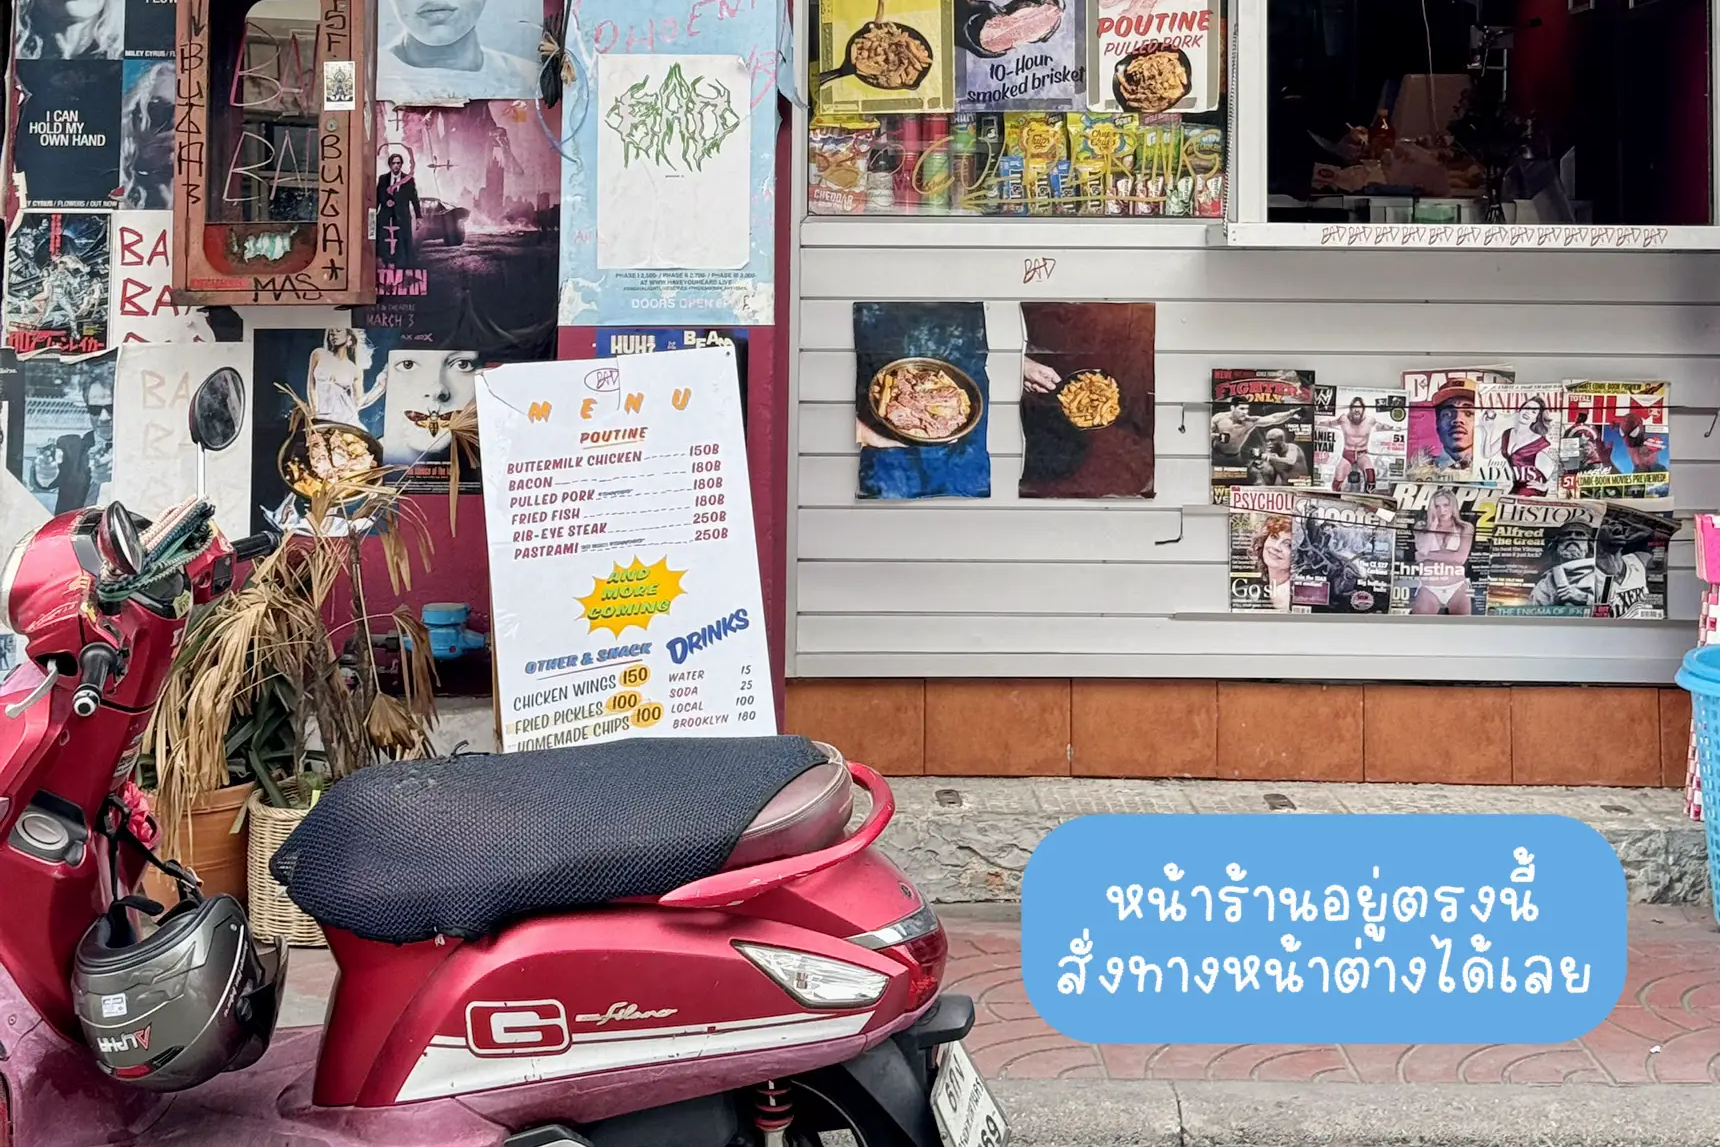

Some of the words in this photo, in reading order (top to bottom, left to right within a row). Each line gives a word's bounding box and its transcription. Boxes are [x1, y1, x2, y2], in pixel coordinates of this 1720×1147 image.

[1096, 9, 1214, 39] POUTINE
[1104, 36, 1161, 56] PULLED
[1162, 33, 1204, 50] PORK
[988, 53, 1055, 82] 10-Hour
[967, 76, 1030, 103] smoked
[1030, 65, 1086, 91] brisket
[29, 122, 64, 134] HOLD
[66, 122, 85, 134] MY
[46, 110, 50, 122] I
[53, 110, 79, 122] CAN
[40, 134, 70, 146] OWN
[72, 134, 106, 146] HAND
[1023, 257, 1056, 284] BAD
[631, 298, 676, 309] DOORS
[679, 298, 713, 309] OPEN
[366, 313, 403, 328] MARCH
[408, 313, 415, 328] 3
[527, 388, 692, 423] MENU
[1567, 395, 1664, 424] FILM
[1569, 394, 1591, 402] TOTAL
[580, 427, 649, 444] POUTINE
[507, 456, 583, 475] BUTTERMILK
[587, 450, 642, 467] CHICKEN
[689, 444, 720, 456] 150B
[508, 477, 553, 492] BACON
[691, 461, 722, 474] 180B
[510, 492, 558, 508] PULLED
[562, 489, 596, 504] PORK
[693, 477, 724, 490] 180B
[511, 511, 548, 525] FRIED
[551, 508, 581, 521] FISH
[695, 494, 725, 507] 180B
[513, 527, 564, 543] RIB-EYE
[567, 523, 608, 537] STEAK
[692, 511, 727, 524] 250B
[1495, 526, 1545, 537] Alfred
[514, 543, 579, 560] PASTRAMI
[694, 528, 729, 541] 250B
[1493, 536, 1511, 545] the
[1513, 536, 1545, 546] Great
[606, 568, 651, 585] AND
[600, 584, 659, 601] MORE
[587, 600, 672, 620] COMING
[665, 608, 750, 665] DRINKS
[524, 653, 579, 675] OTHER
[580, 652, 594, 666] &
[596, 642, 653, 662] SNACK
[668, 669, 705, 683] WATER
[741, 665, 752, 676] 15
[513, 686, 568, 712] CHICKEN
[573, 675, 617, 696] WINGS
[622, 667, 649, 685] 150
[669, 686, 699, 698] SODA
[740, 680, 753, 691] 25
[515, 712, 549, 735] FRIED
[553, 702, 604, 724] PICKLES
[612, 693, 638, 710] 100
[671, 701, 705, 714] LOCAL
[735, 695, 755, 707] 100
[517, 725, 590, 753] HOMEMADE
[593, 716, 630, 737] CHIPS
[636, 706, 662, 723] 100
[672, 713, 730, 730] BROOKLYN
[737, 710, 756, 722] 180
